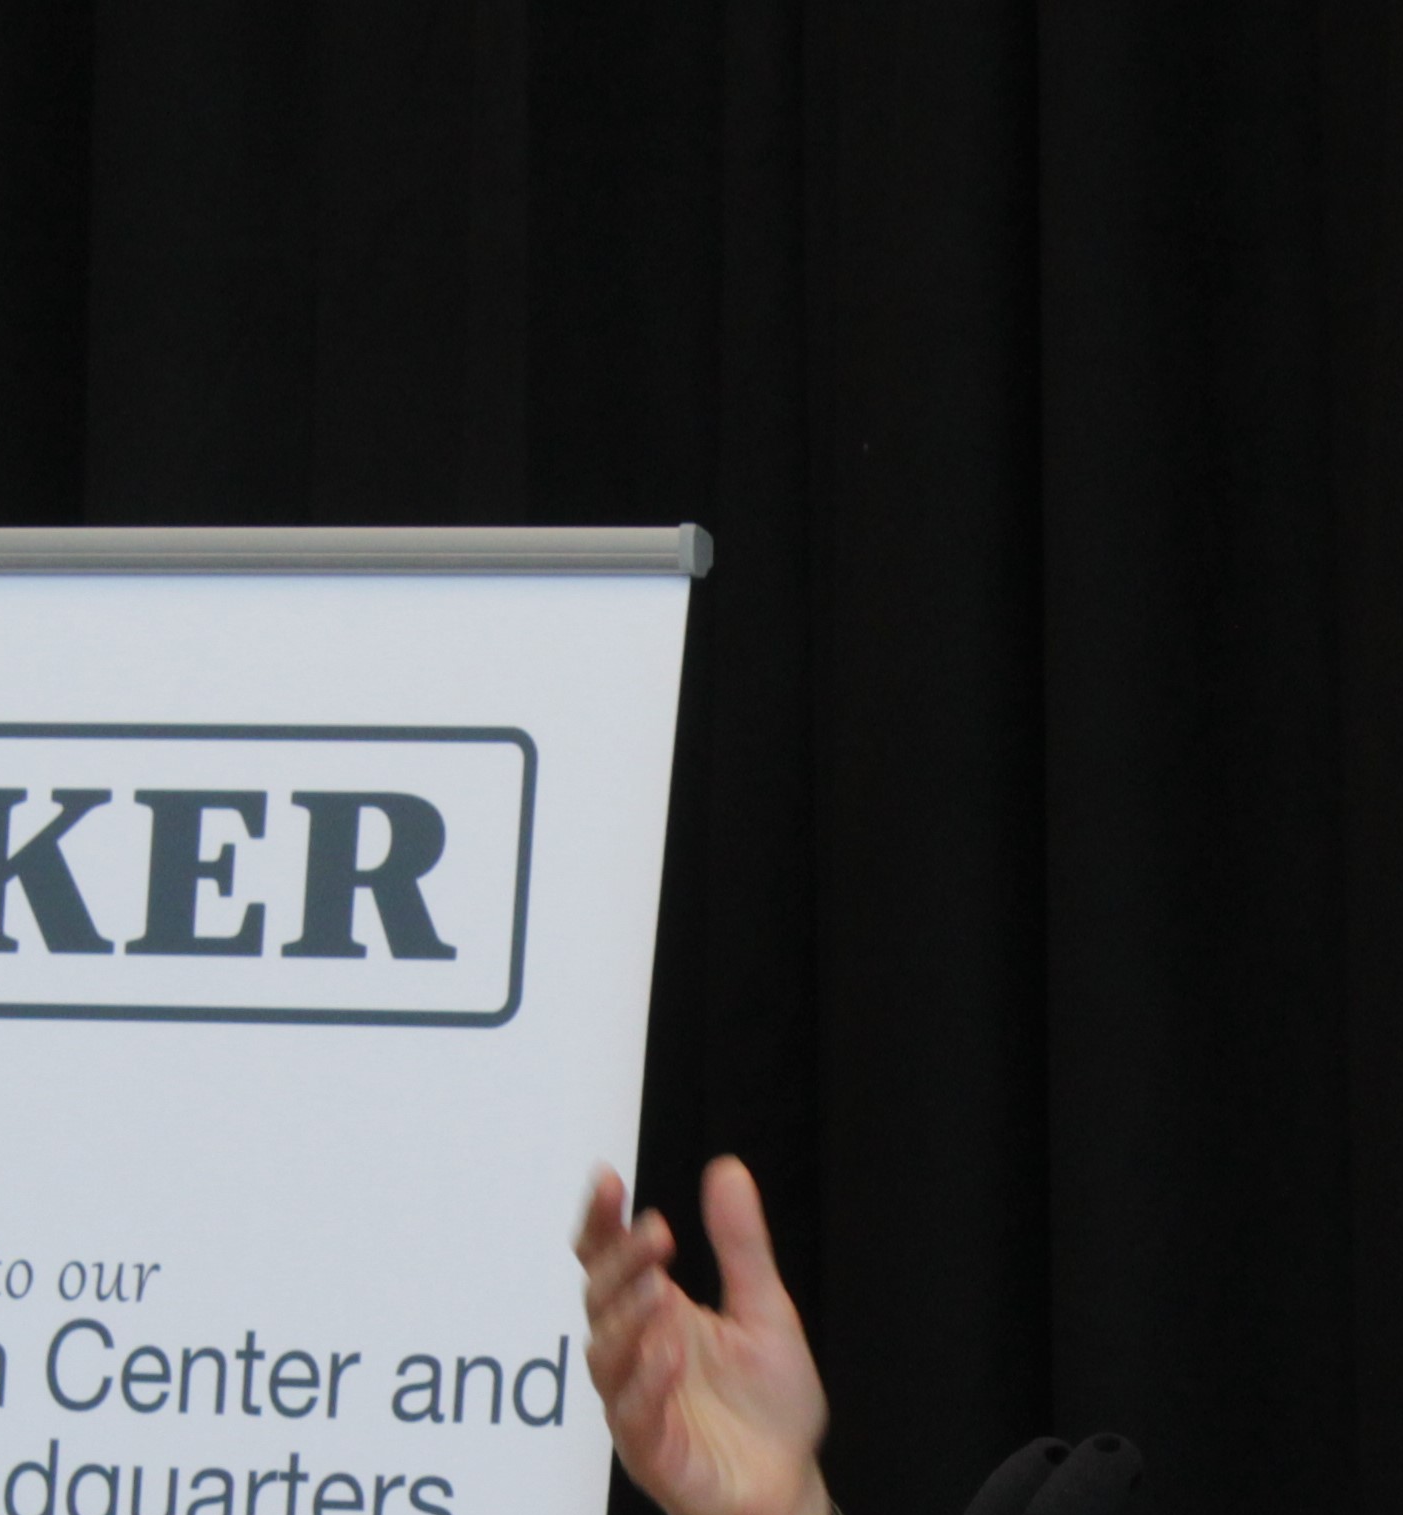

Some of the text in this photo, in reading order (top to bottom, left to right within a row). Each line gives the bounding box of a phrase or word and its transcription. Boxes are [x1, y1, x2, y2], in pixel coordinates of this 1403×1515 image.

[57, 1259, 162, 1303] our
[45, 1317, 362, 1420] Center
[390, 1334, 570, 1428] and
